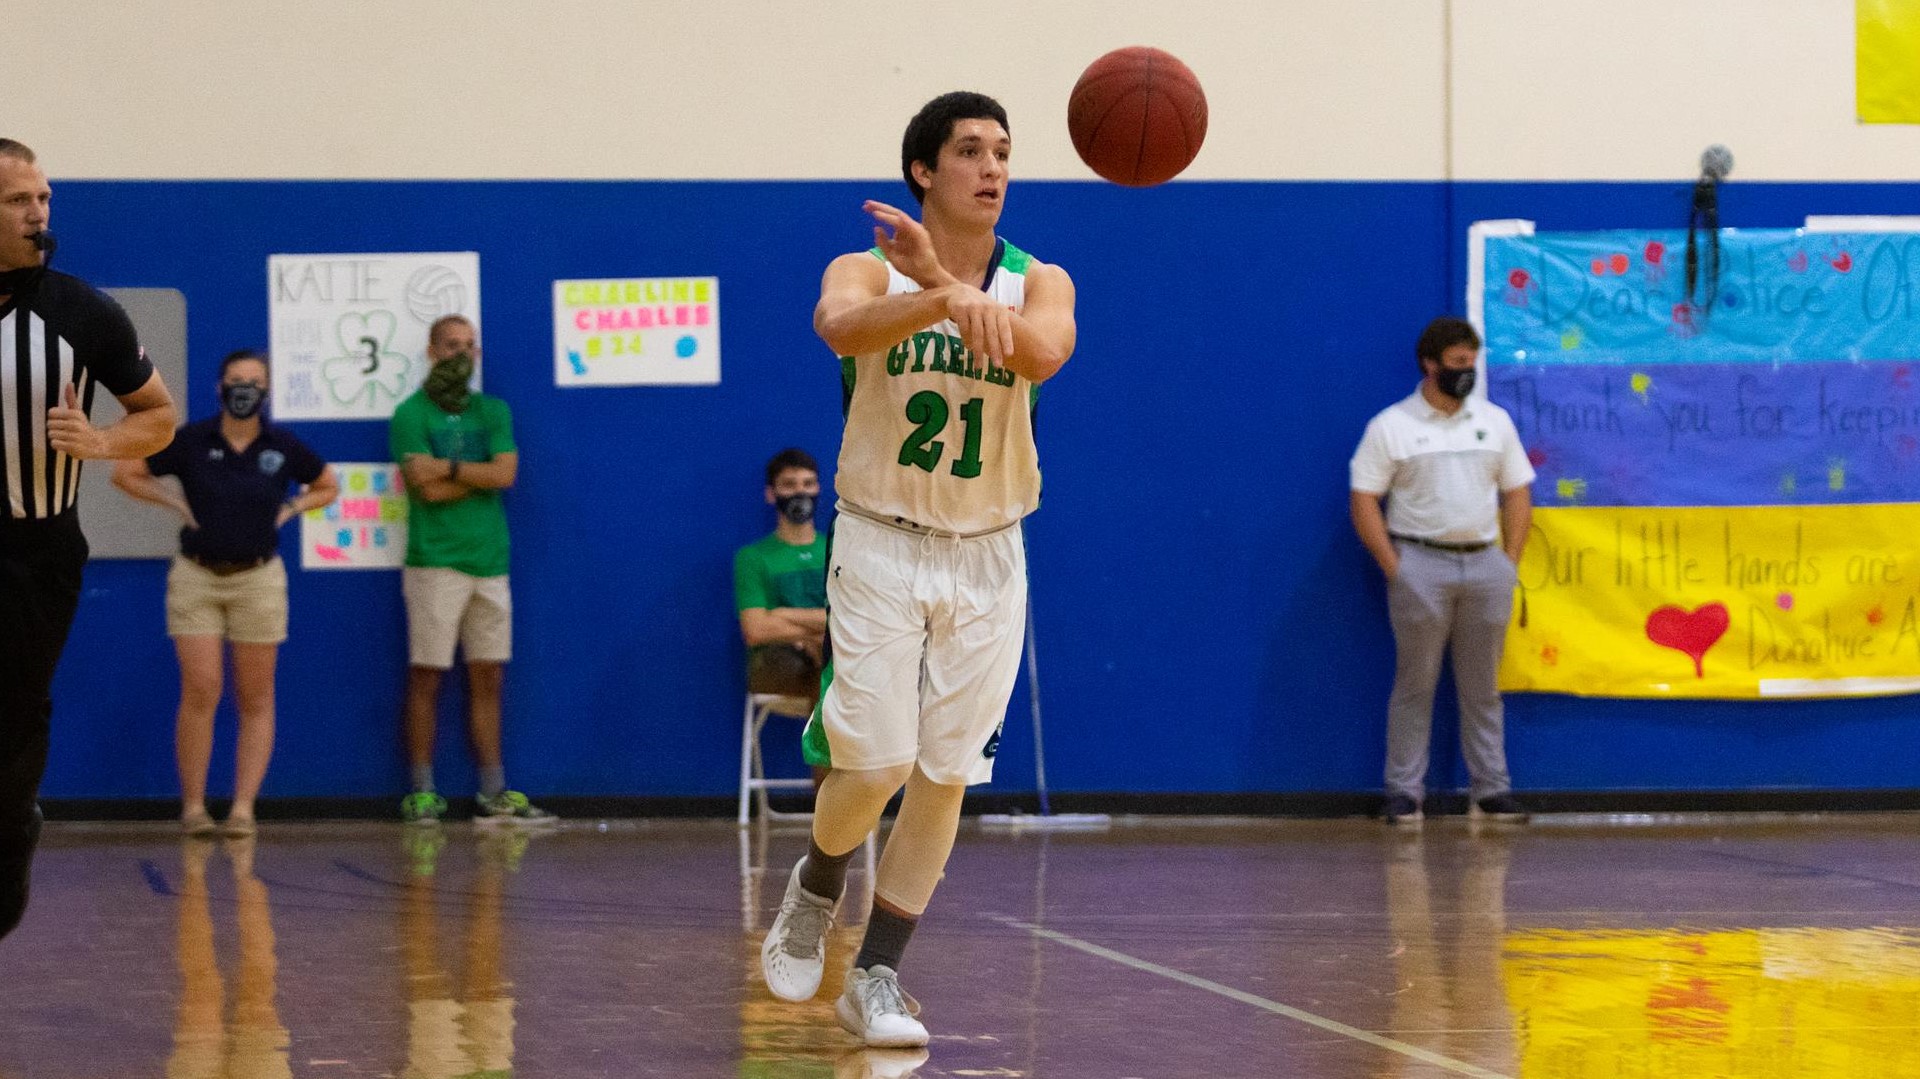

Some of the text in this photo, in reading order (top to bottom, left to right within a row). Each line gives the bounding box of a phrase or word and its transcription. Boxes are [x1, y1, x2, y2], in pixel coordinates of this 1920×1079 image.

[276, 259, 387, 302] KATIE
[897, 389, 984, 479] 21
[1518, 517, 1904, 592] Our little hands are
